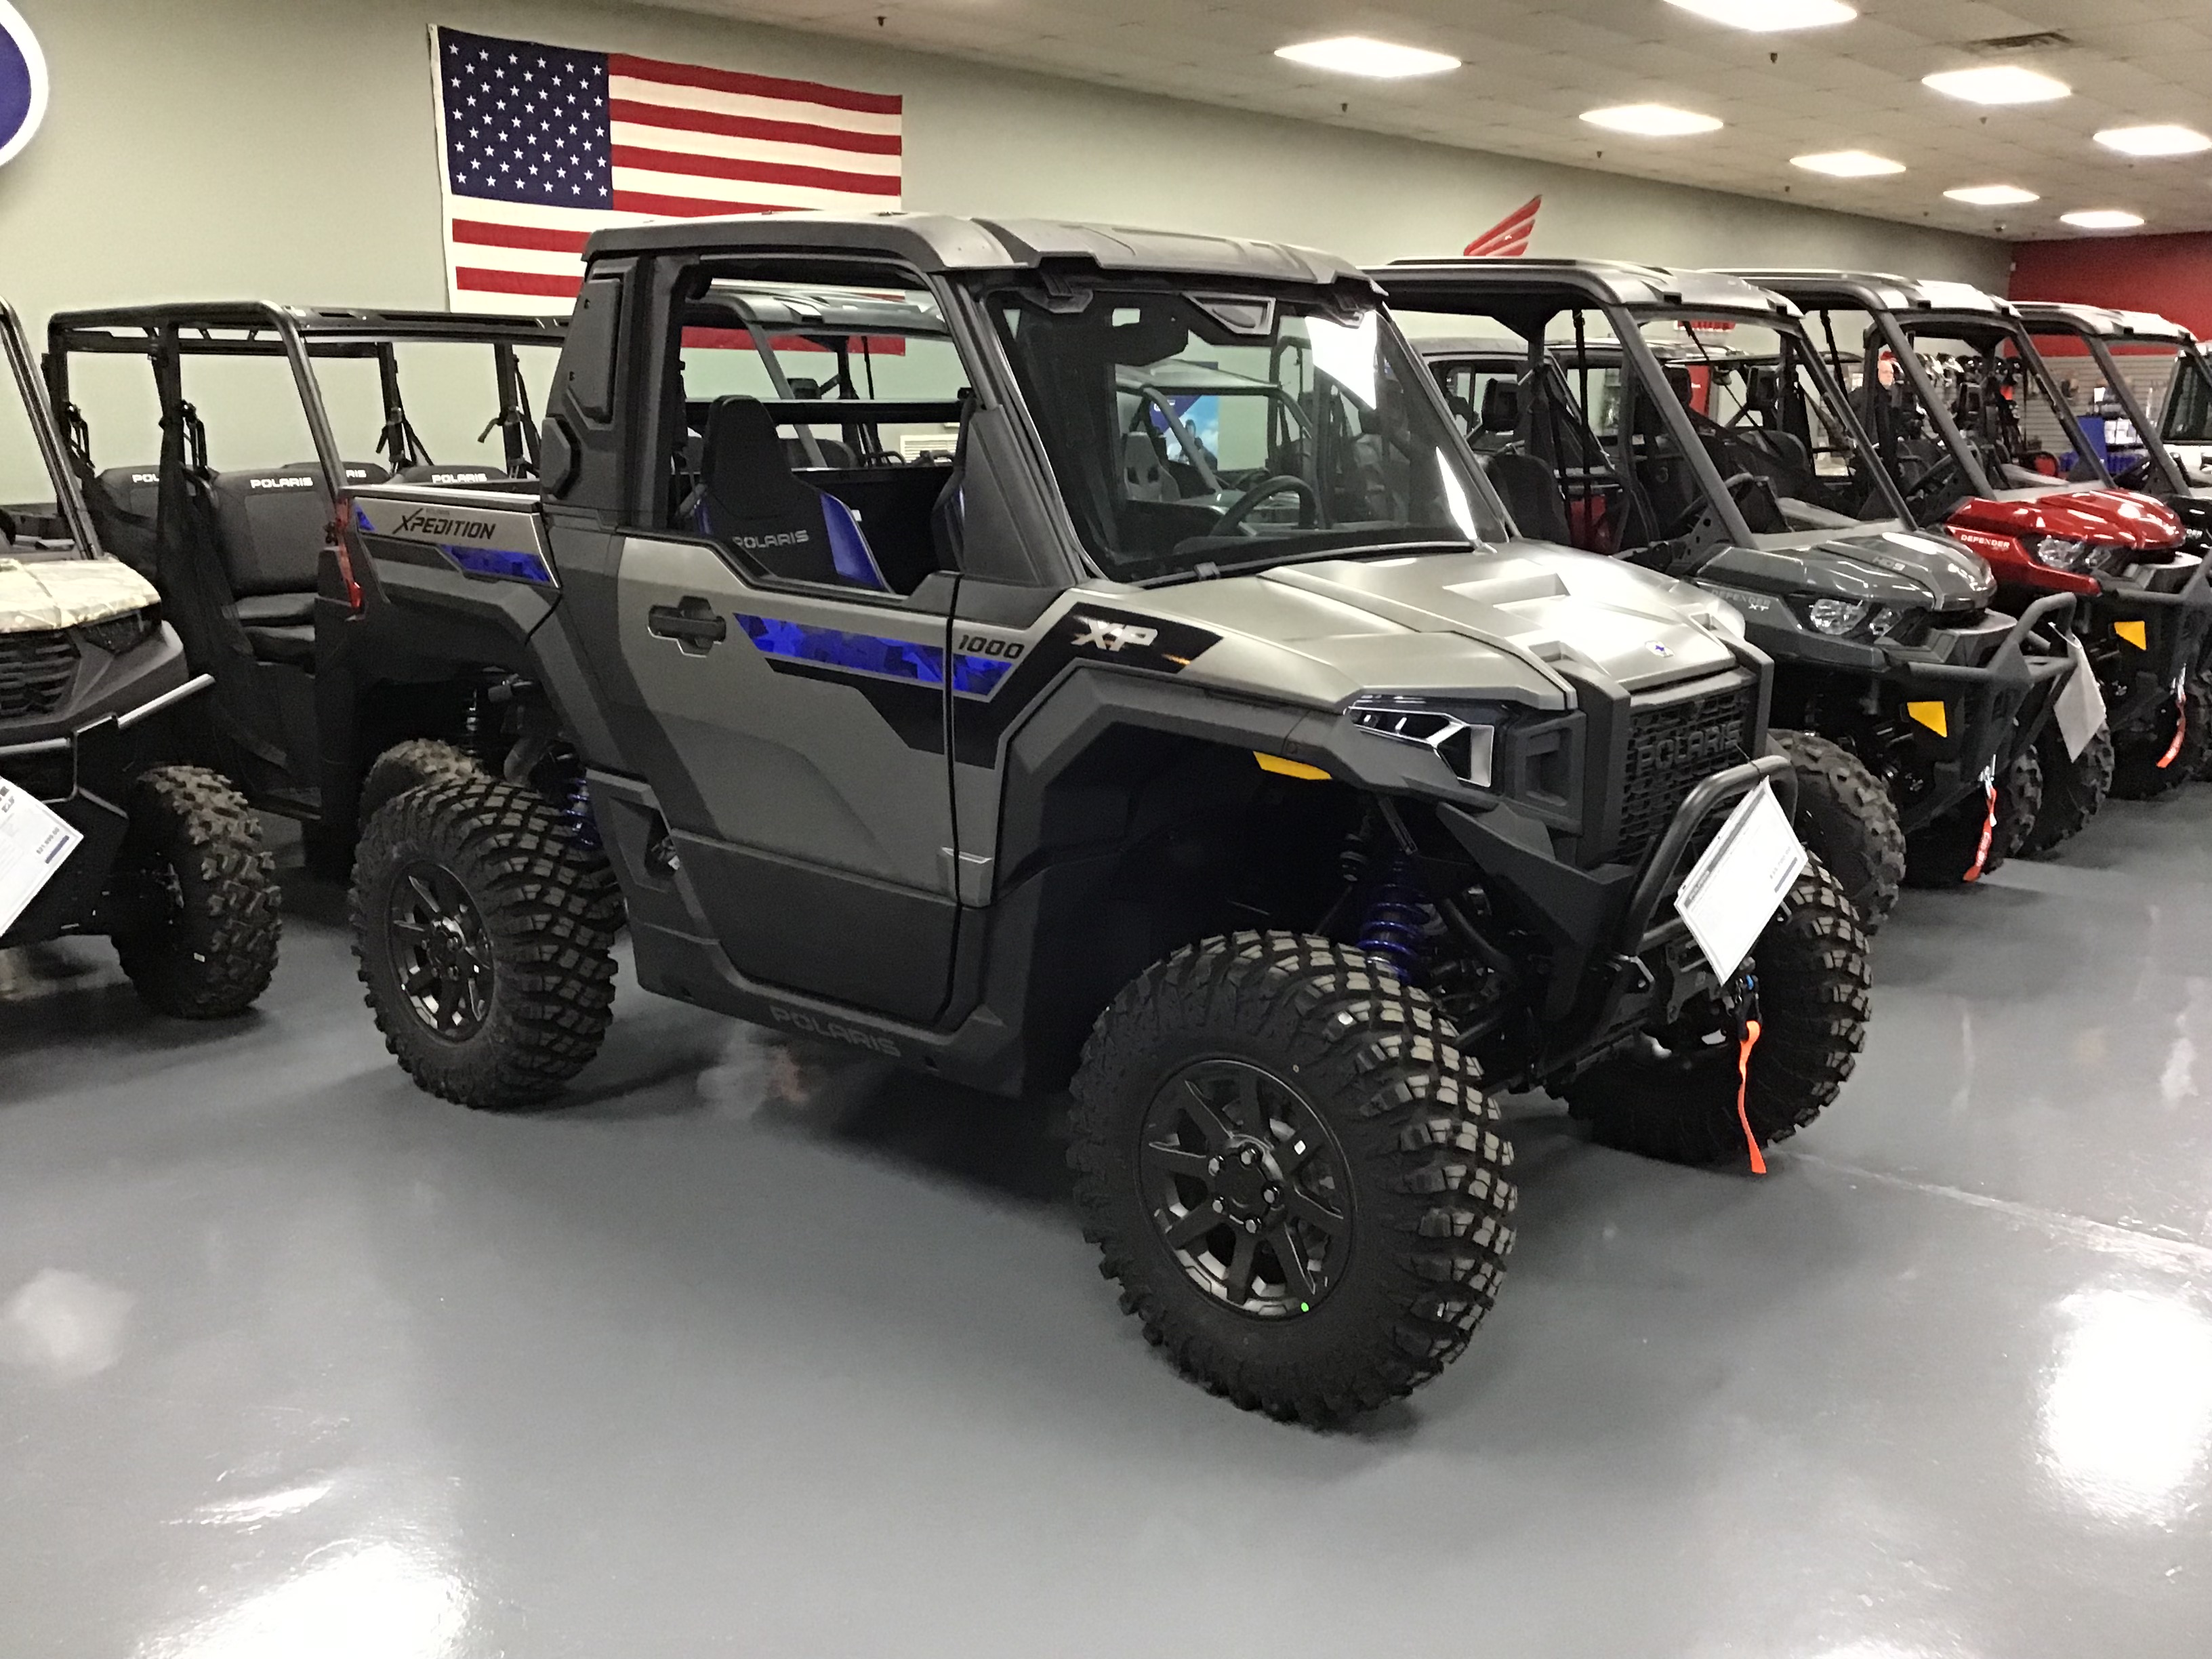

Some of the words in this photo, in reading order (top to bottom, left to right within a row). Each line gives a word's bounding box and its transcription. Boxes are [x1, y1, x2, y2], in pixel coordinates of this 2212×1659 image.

[132, 474, 159, 483] POL
[250, 476, 312, 489] POLARIS
[432, 474, 487, 483] POLARIS
[392, 508, 495, 539] XPEDITION
[733, 529, 809, 548] POLARIS
[1961, 534, 2010, 549] DEFENDER
[1748, 603, 1769, 611] XT
[1071, 615, 1158, 652] XP
[958, 634, 1025, 659] 1000
[1637, 720, 1742, 774] POLARIS
[769, 1005, 902, 1057] POLARIS
